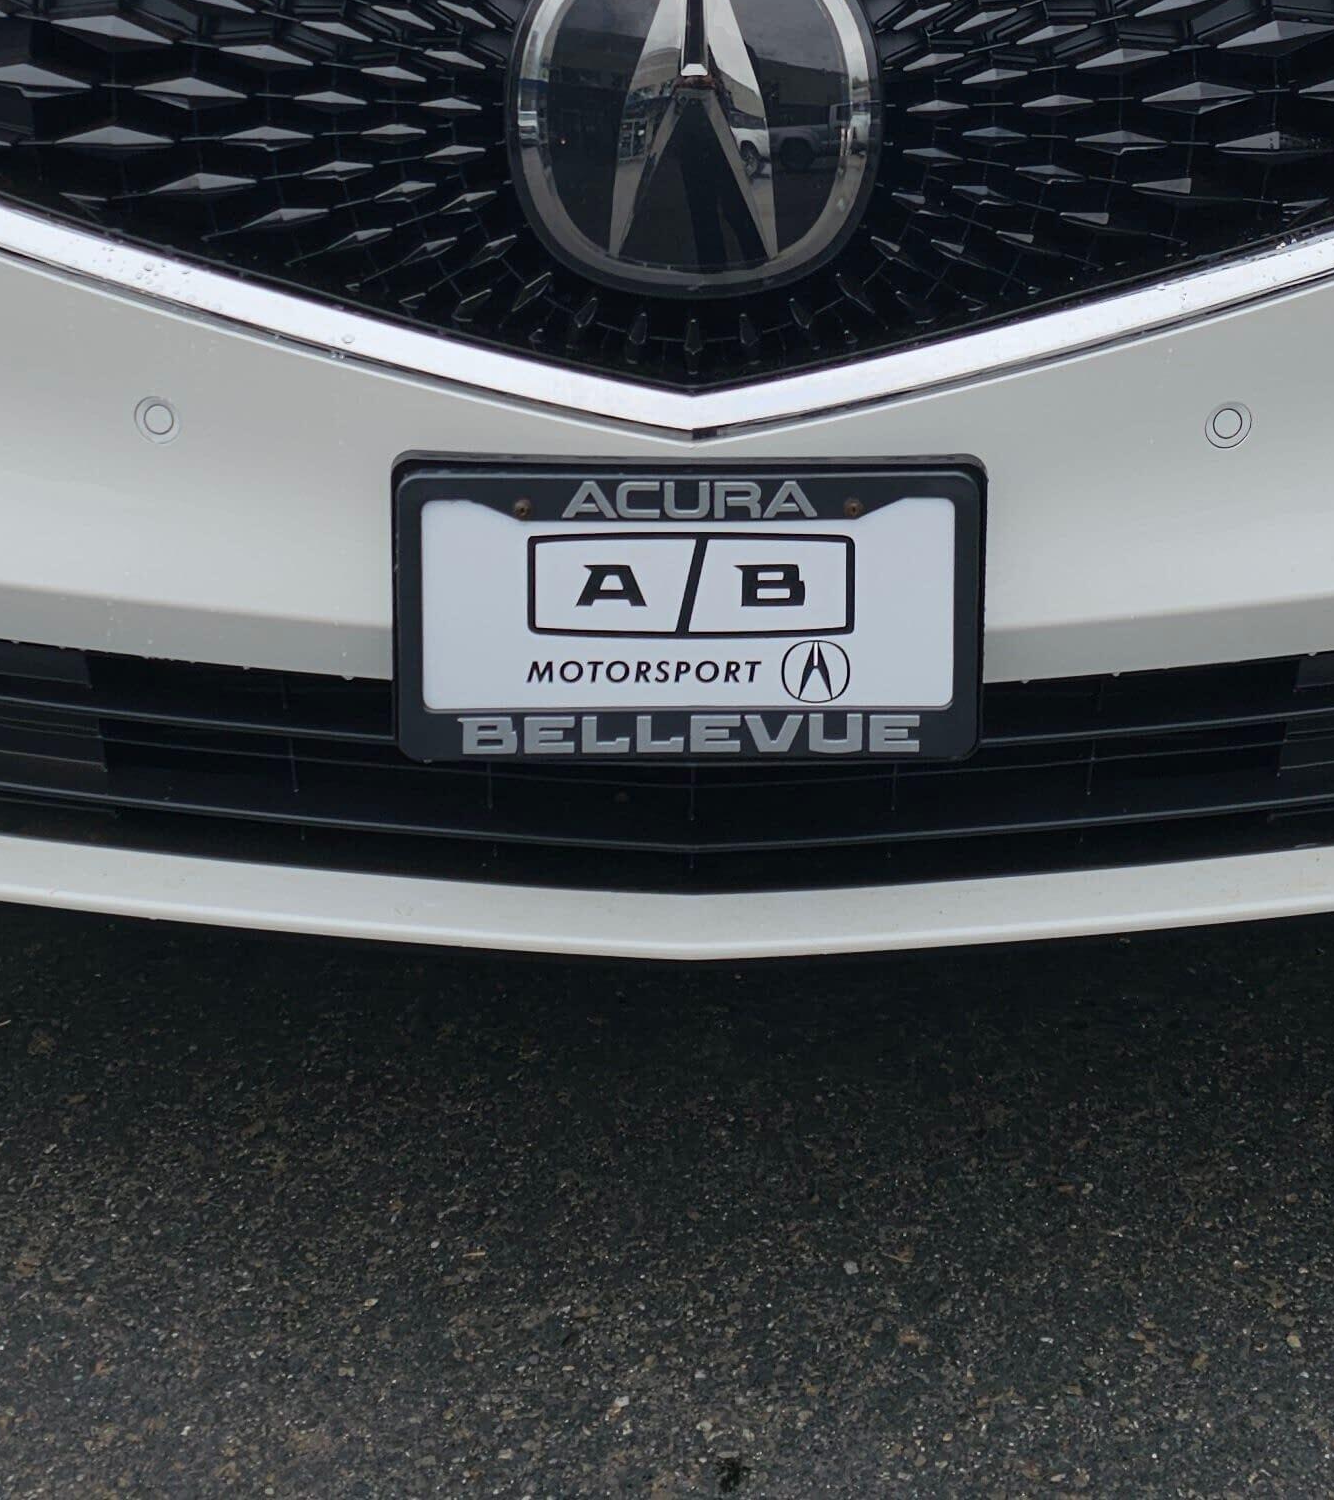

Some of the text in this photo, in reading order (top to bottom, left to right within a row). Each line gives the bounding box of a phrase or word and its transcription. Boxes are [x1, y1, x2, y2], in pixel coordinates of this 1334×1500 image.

[562, 480, 818, 520] ACURA
[526, 660, 763, 684] MOTORSPORT
[456, 713, 921, 755] BELLEVUE
